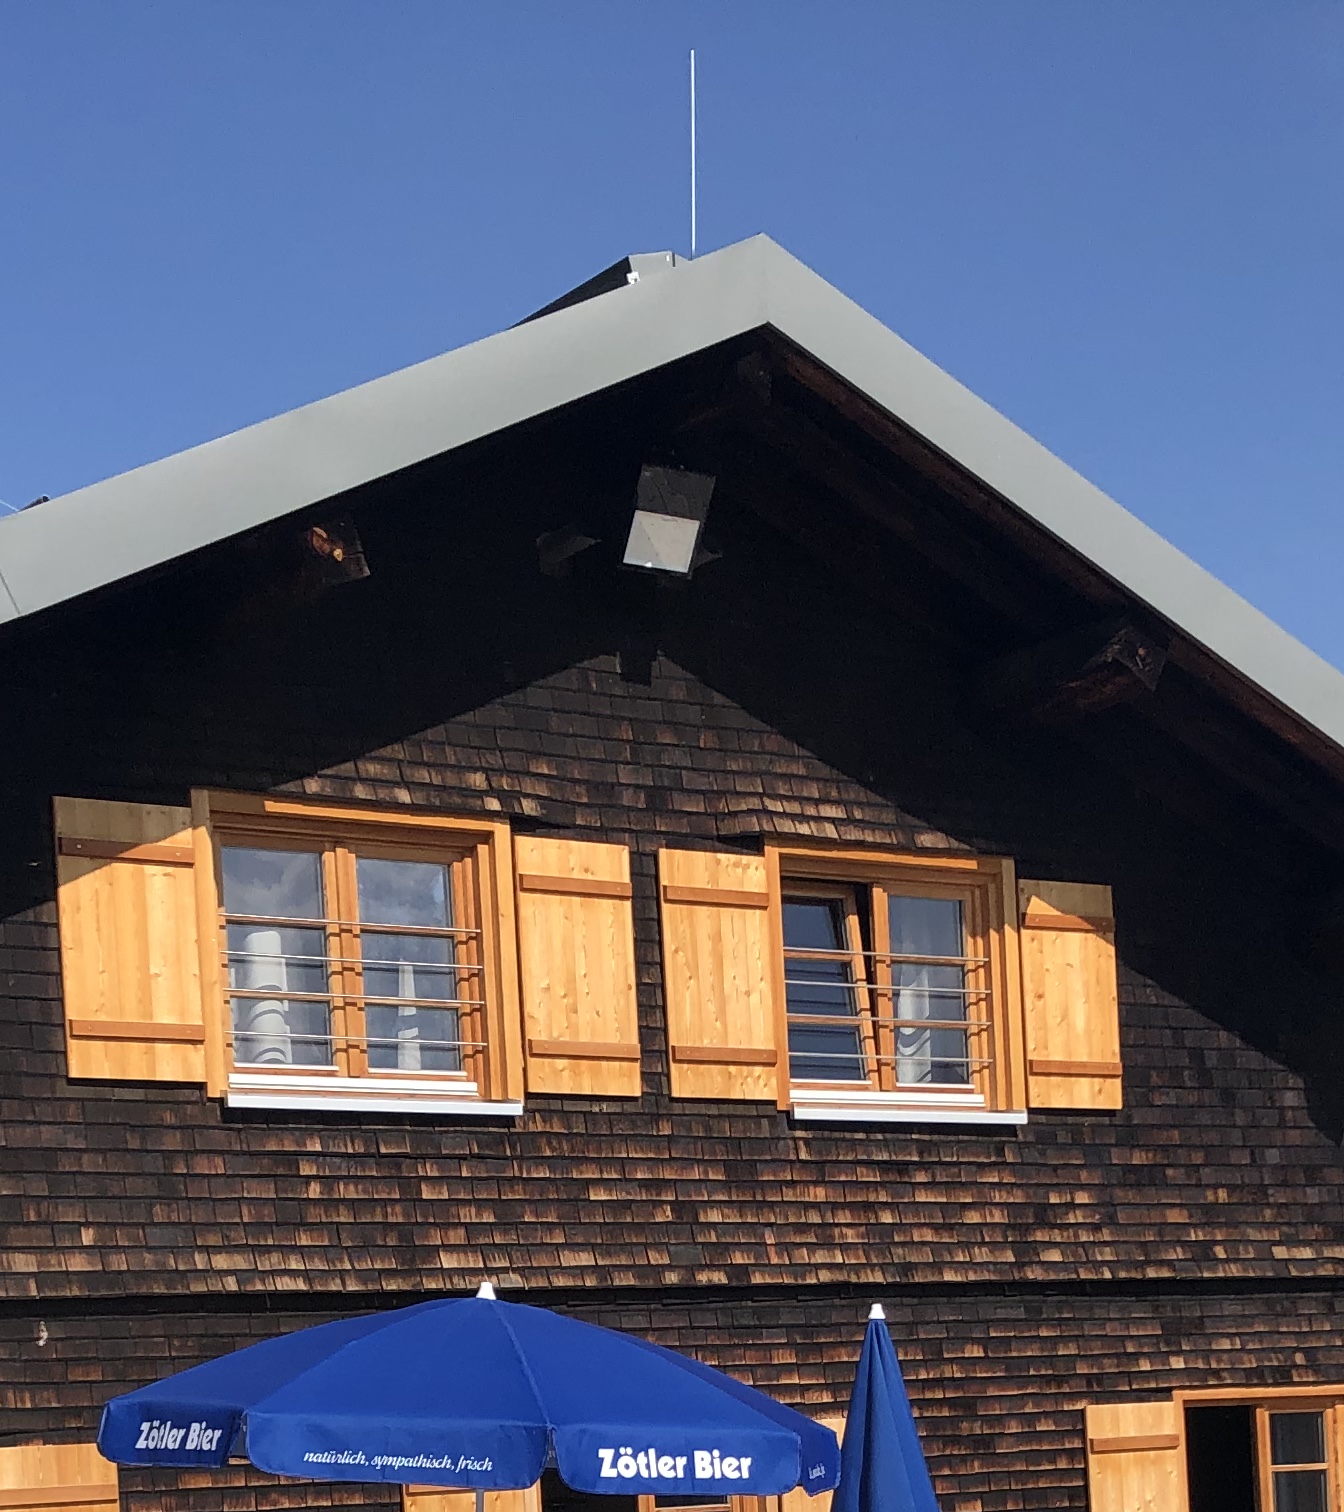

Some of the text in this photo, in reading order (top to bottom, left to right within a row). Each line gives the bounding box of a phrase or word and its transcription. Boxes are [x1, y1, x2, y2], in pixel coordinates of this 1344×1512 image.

[135, 1420, 222, 1451] Zötler Bier
[303, 1450, 493, 1473] natürlich, sympathisch, frisch
[598, 1446, 752, 1480] Zötler Bier
